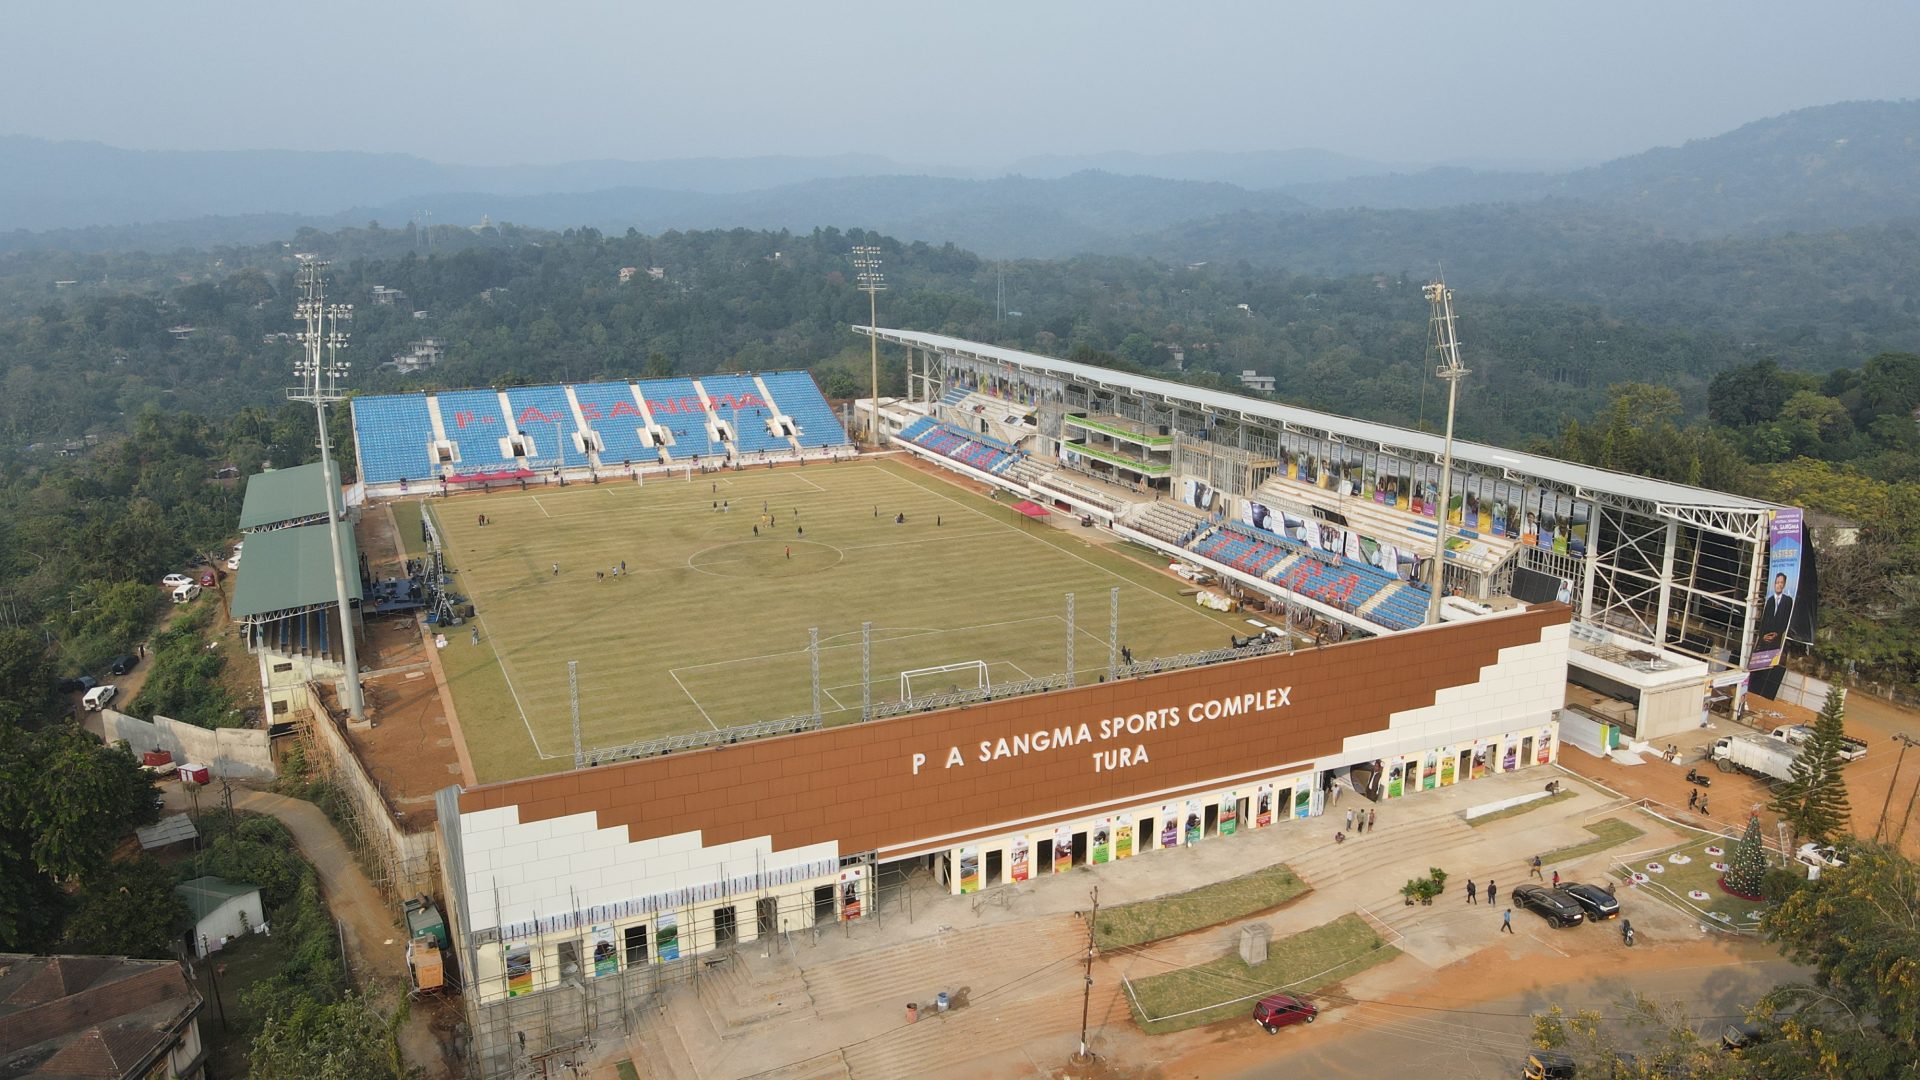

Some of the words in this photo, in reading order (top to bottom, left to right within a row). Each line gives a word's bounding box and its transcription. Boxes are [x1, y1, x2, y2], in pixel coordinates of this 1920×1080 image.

[578, 393, 767, 421] SANGMA
[912, 753, 927, 775] P
[945, 746, 965, 769] A
[979, 723, 1092, 763] SANGMA
[1099, 706, 1180, 740] SPORTS
[1188, 686, 1292, 724] COMPLEX
[1092, 744, 1149, 773] TURA
